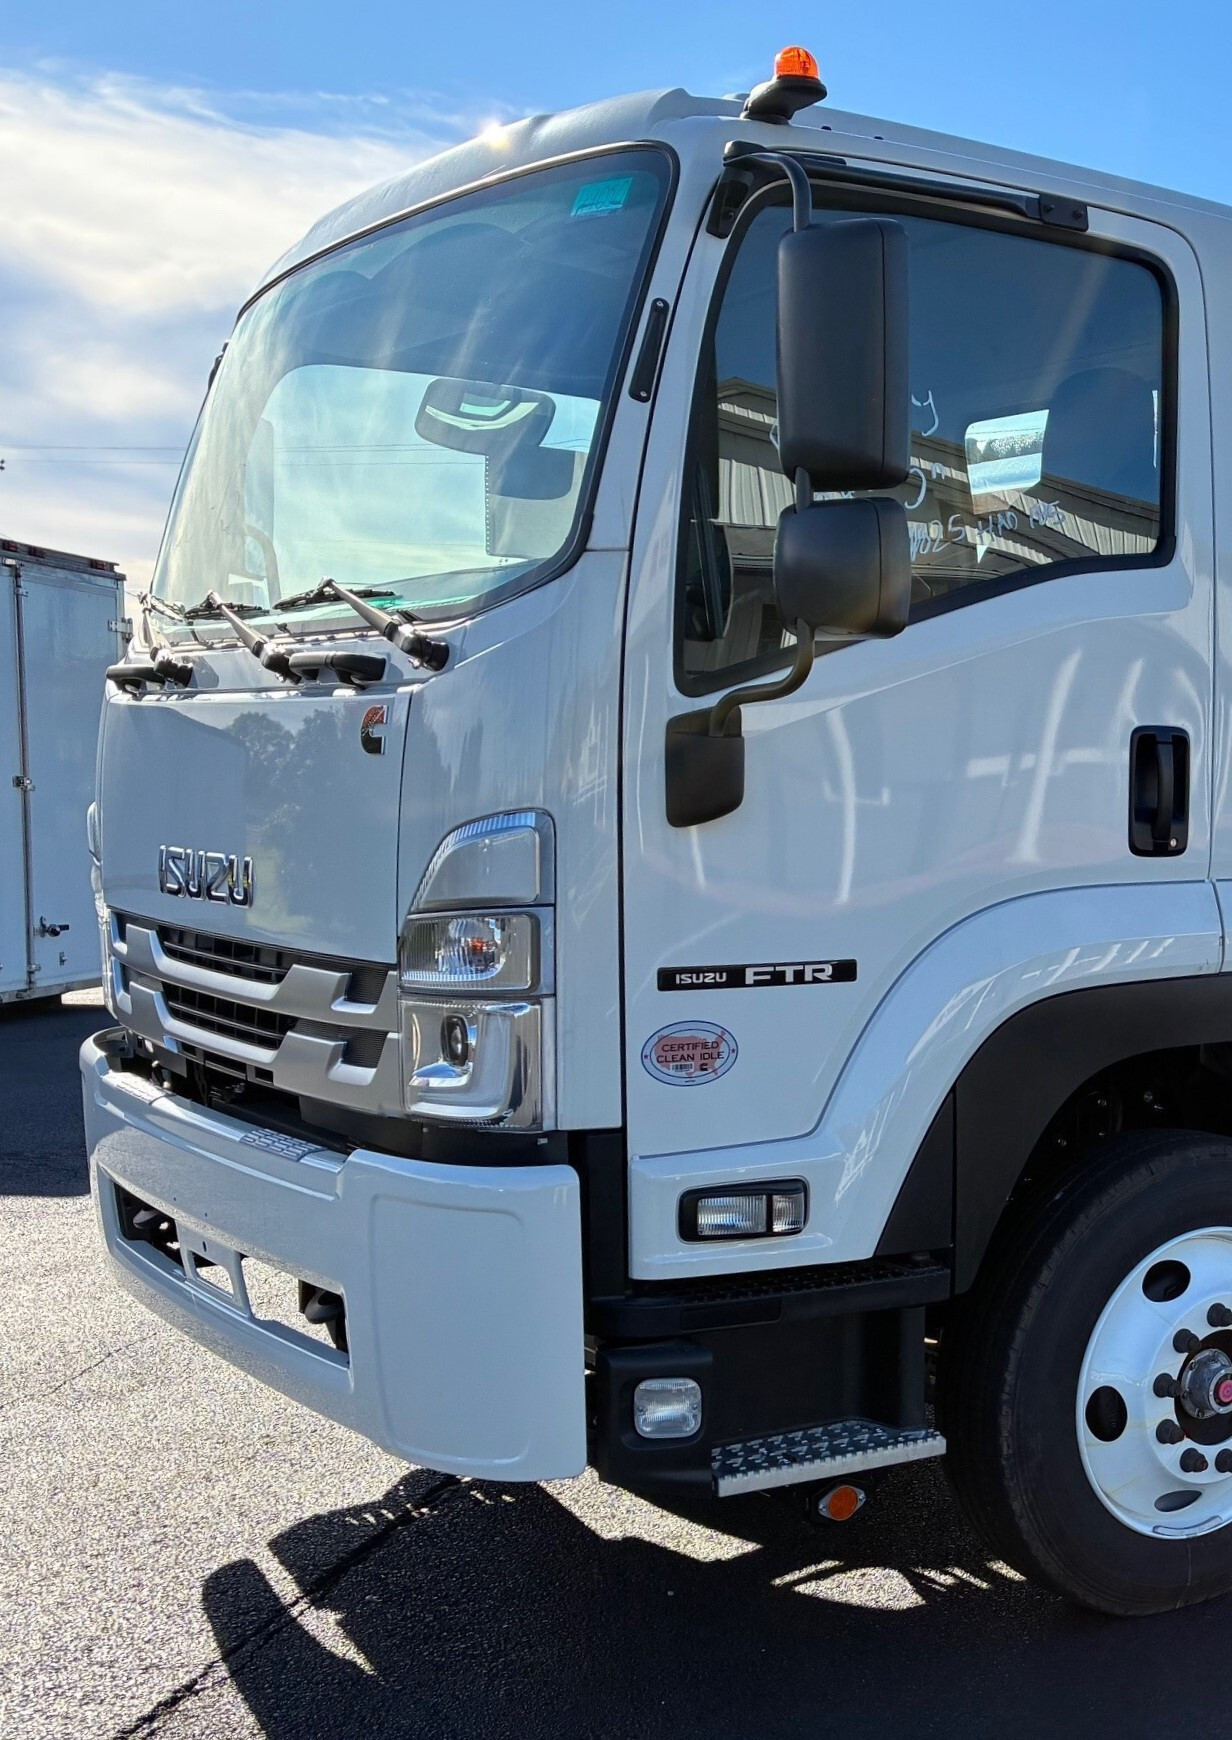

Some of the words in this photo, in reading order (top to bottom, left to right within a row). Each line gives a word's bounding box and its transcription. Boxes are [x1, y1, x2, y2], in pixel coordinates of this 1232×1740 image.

[159, 845, 254, 909] ISUZU
[675, 972, 727, 985] ISUZU
[744, 961, 839, 985] FTR
[661, 1040, 720, 1053] CERTIFIED
[656, 1051, 695, 1064] CLEAN
[700, 1050, 725, 1061] IDLE
